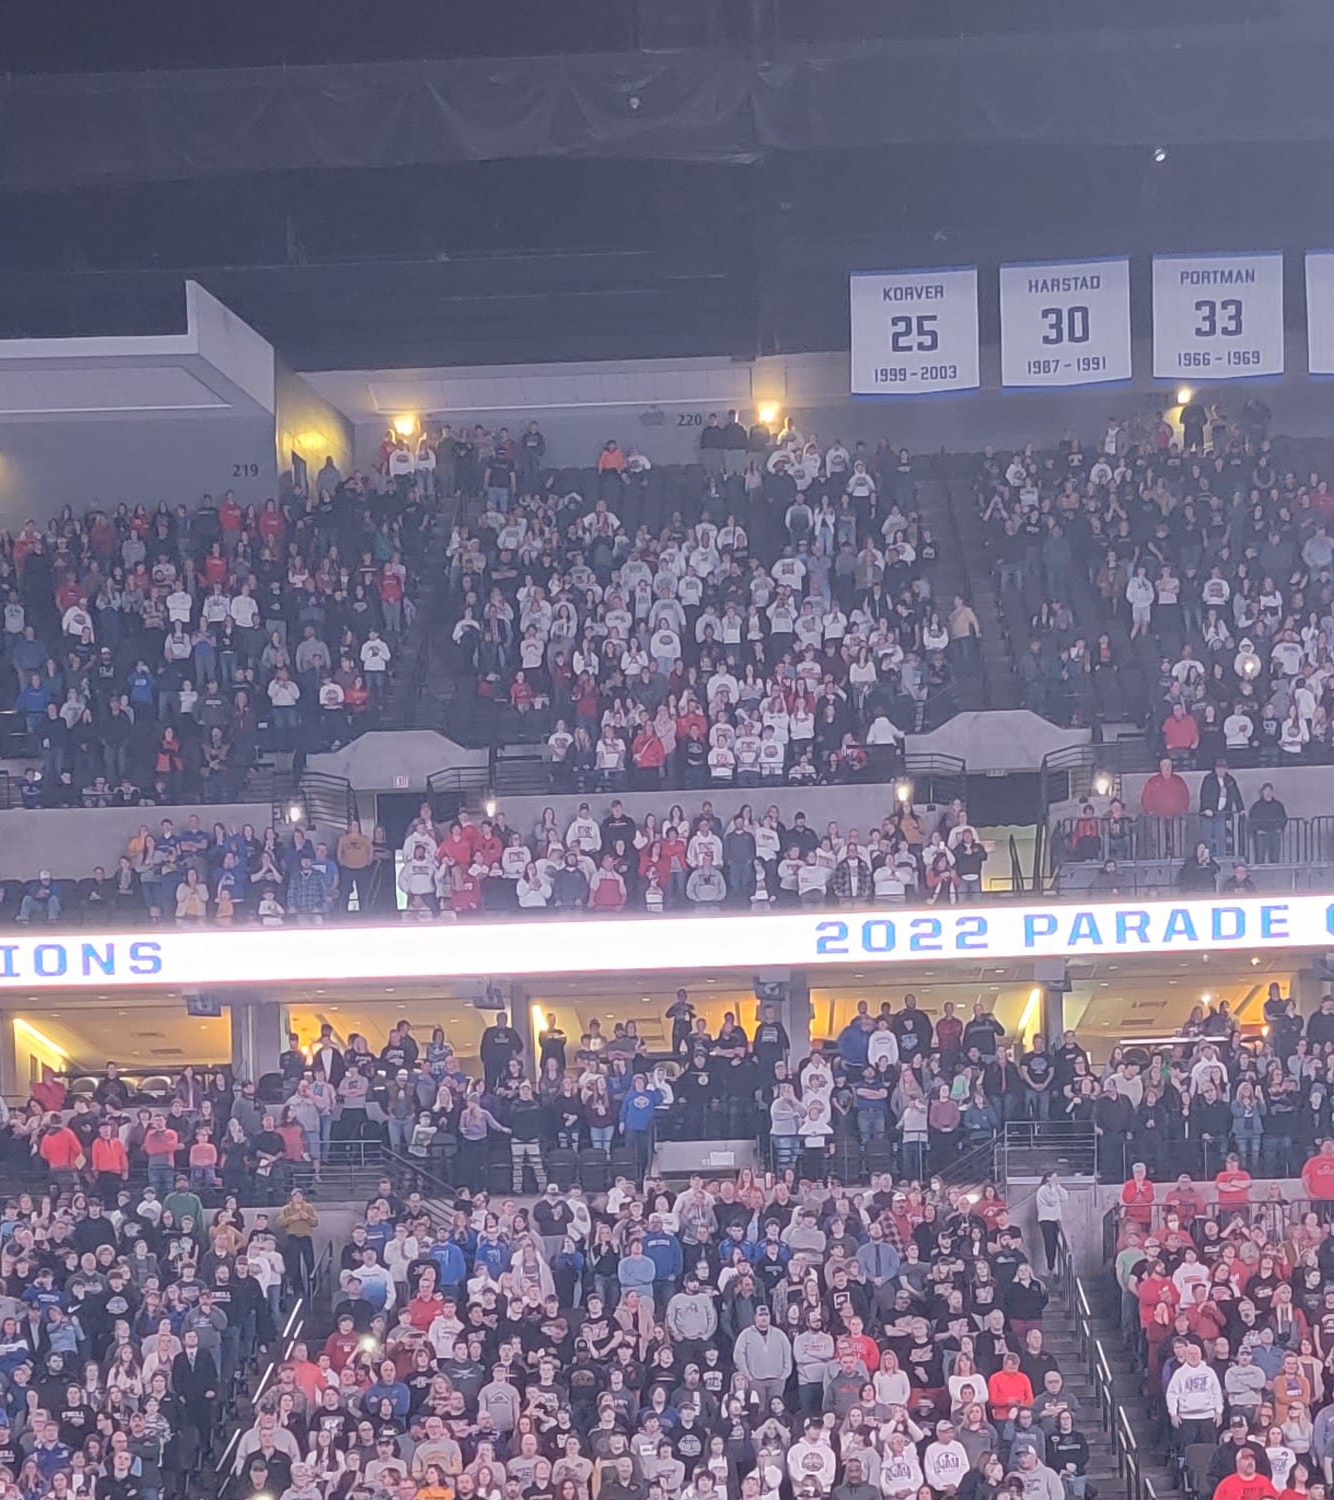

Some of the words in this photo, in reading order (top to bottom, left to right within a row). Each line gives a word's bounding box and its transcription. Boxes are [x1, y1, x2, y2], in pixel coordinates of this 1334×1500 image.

[1028, 275, 1101, 293] HARSTAD
[1180, 269, 1256, 285] PORTMAN
[882, 285, 944, 301] KORVER
[1040, 305, 1089, 345] 30
[1194, 299, 1243, 338] 33
[890, 314, 939, 353] 25
[677, 414, 703, 426] 220
[233, 464, 259, 477] 219
[815, 917, 988, 955] 2022
[1024, 905, 1290, 948] PARADE
